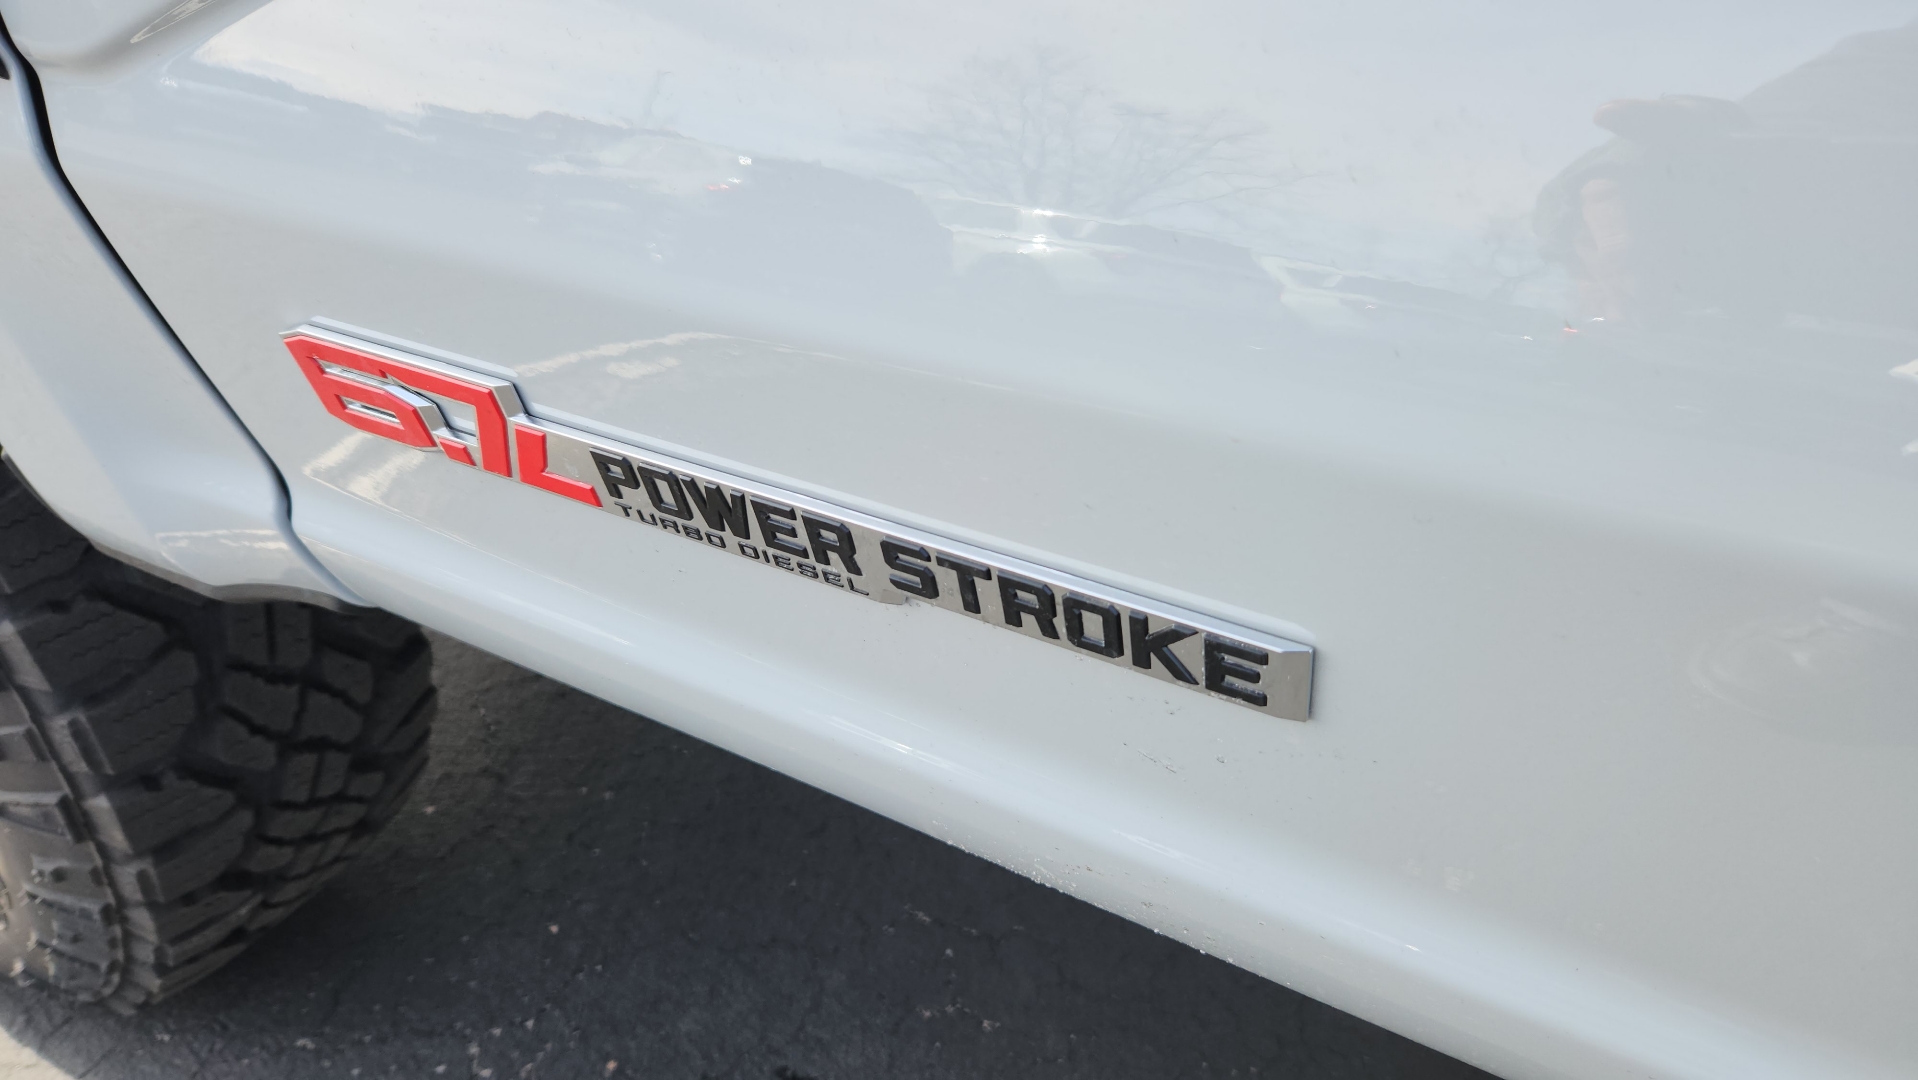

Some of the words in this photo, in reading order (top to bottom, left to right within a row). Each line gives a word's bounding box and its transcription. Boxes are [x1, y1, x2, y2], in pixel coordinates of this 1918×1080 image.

[283, 335, 603, 508] 6.7L
[589, 447, 862, 576] POWER
[880, 535, 1269, 707] STROKE
[614, 501, 727, 549] TURBO
[738, 541, 869, 596] DIESEL
